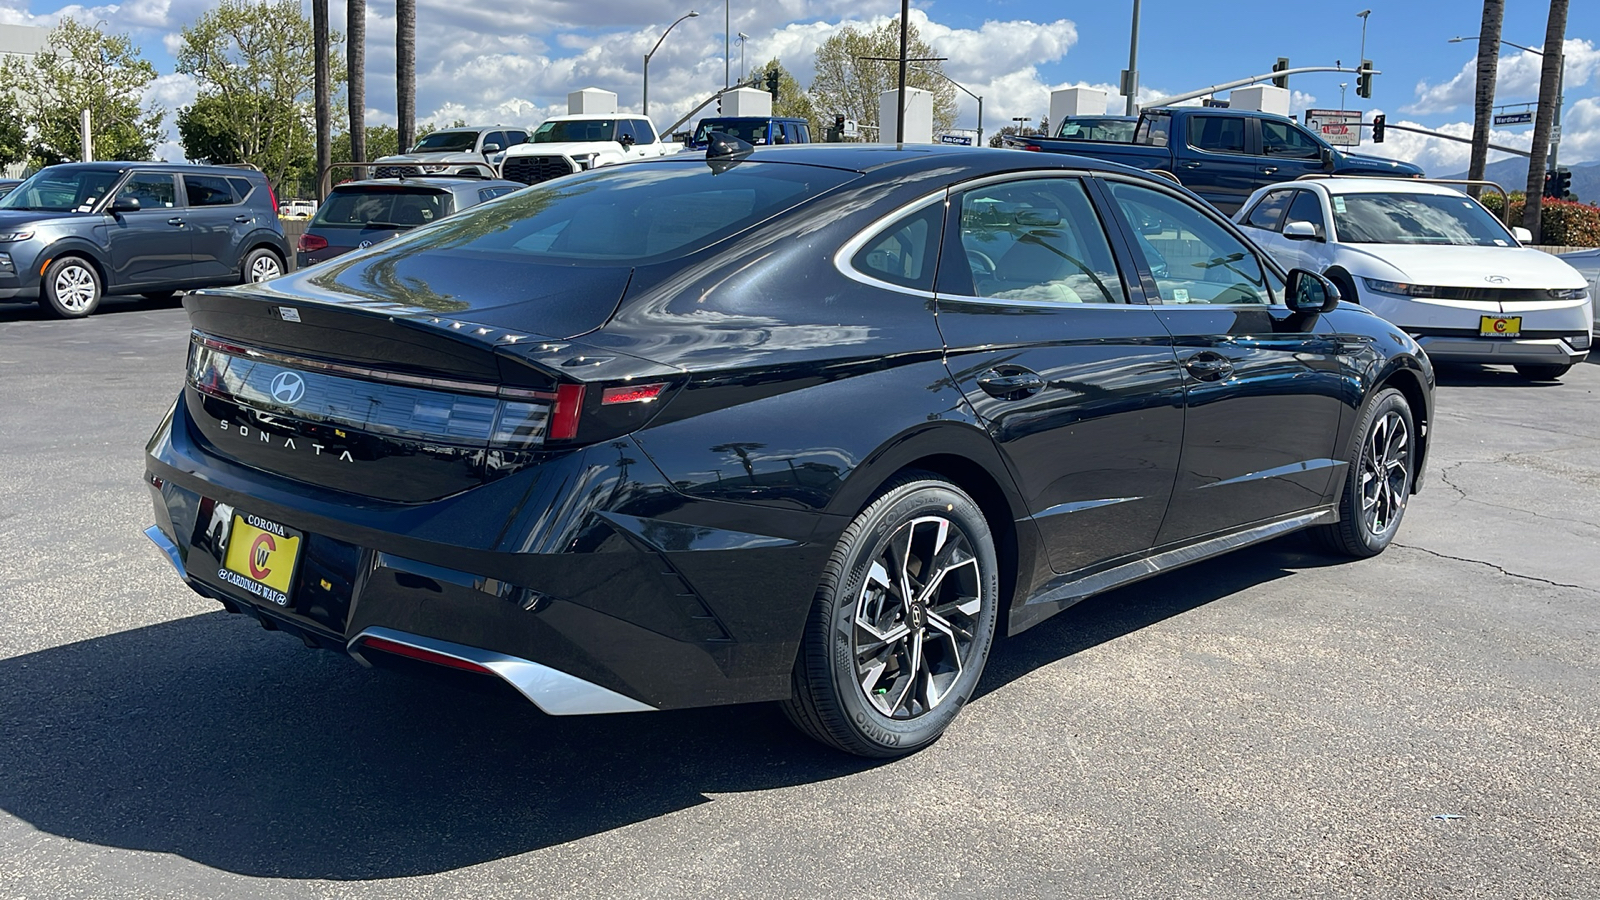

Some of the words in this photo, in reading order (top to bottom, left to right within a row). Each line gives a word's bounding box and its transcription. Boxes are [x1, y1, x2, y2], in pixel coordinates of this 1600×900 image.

[1495, 116, 1520, 124] Wardlow
[220, 419, 354, 463] SONATA
[247, 514, 285, 536] CORONA
[877, 496, 925, 536] SOLUS
[227, 571, 262, 596] CARDINALE
[262, 586, 278, 603] WAY
[855, 711, 902, 747] KUMHO
